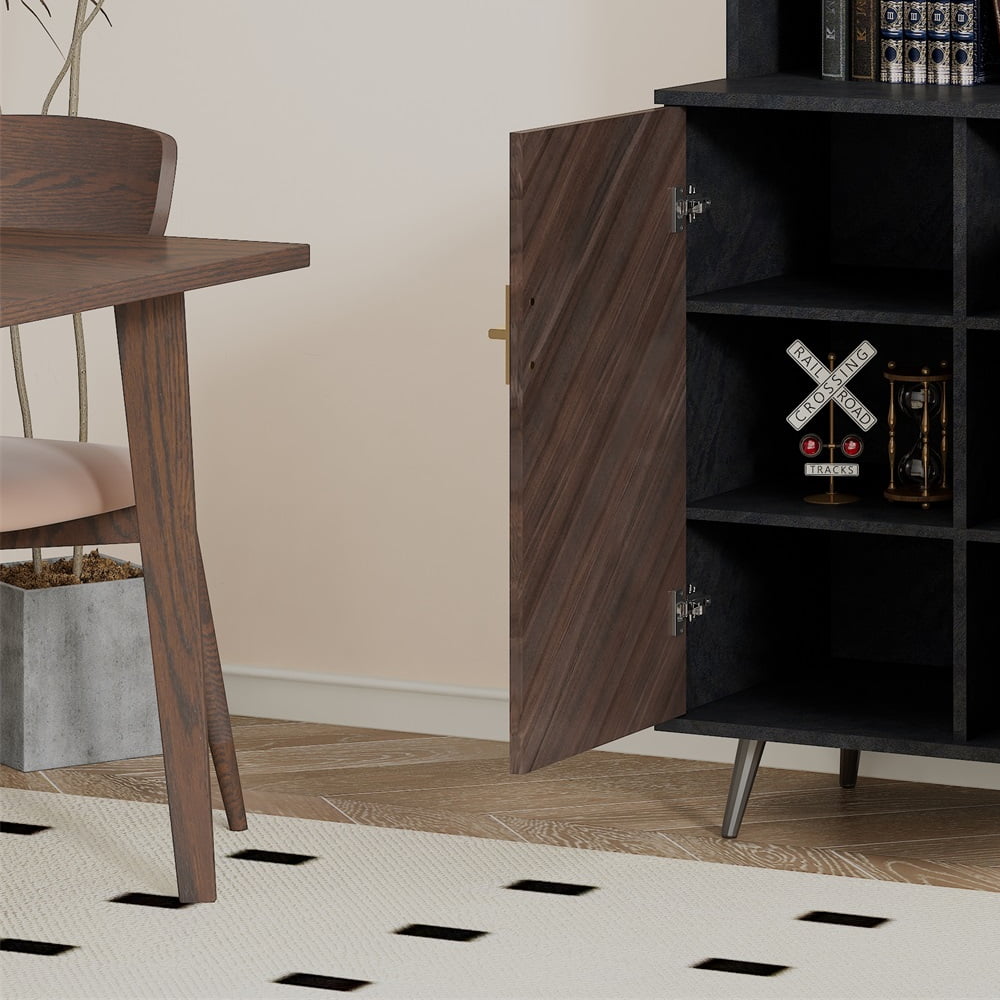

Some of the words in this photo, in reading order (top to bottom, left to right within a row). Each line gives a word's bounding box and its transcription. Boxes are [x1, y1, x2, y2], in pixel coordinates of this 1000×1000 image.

[793, 346, 823, 379] RAIL
[837, 390, 871, 425] ROAD
[795, 348, 869, 422] CROSSING
[810, 465, 854, 474] TRACKS
